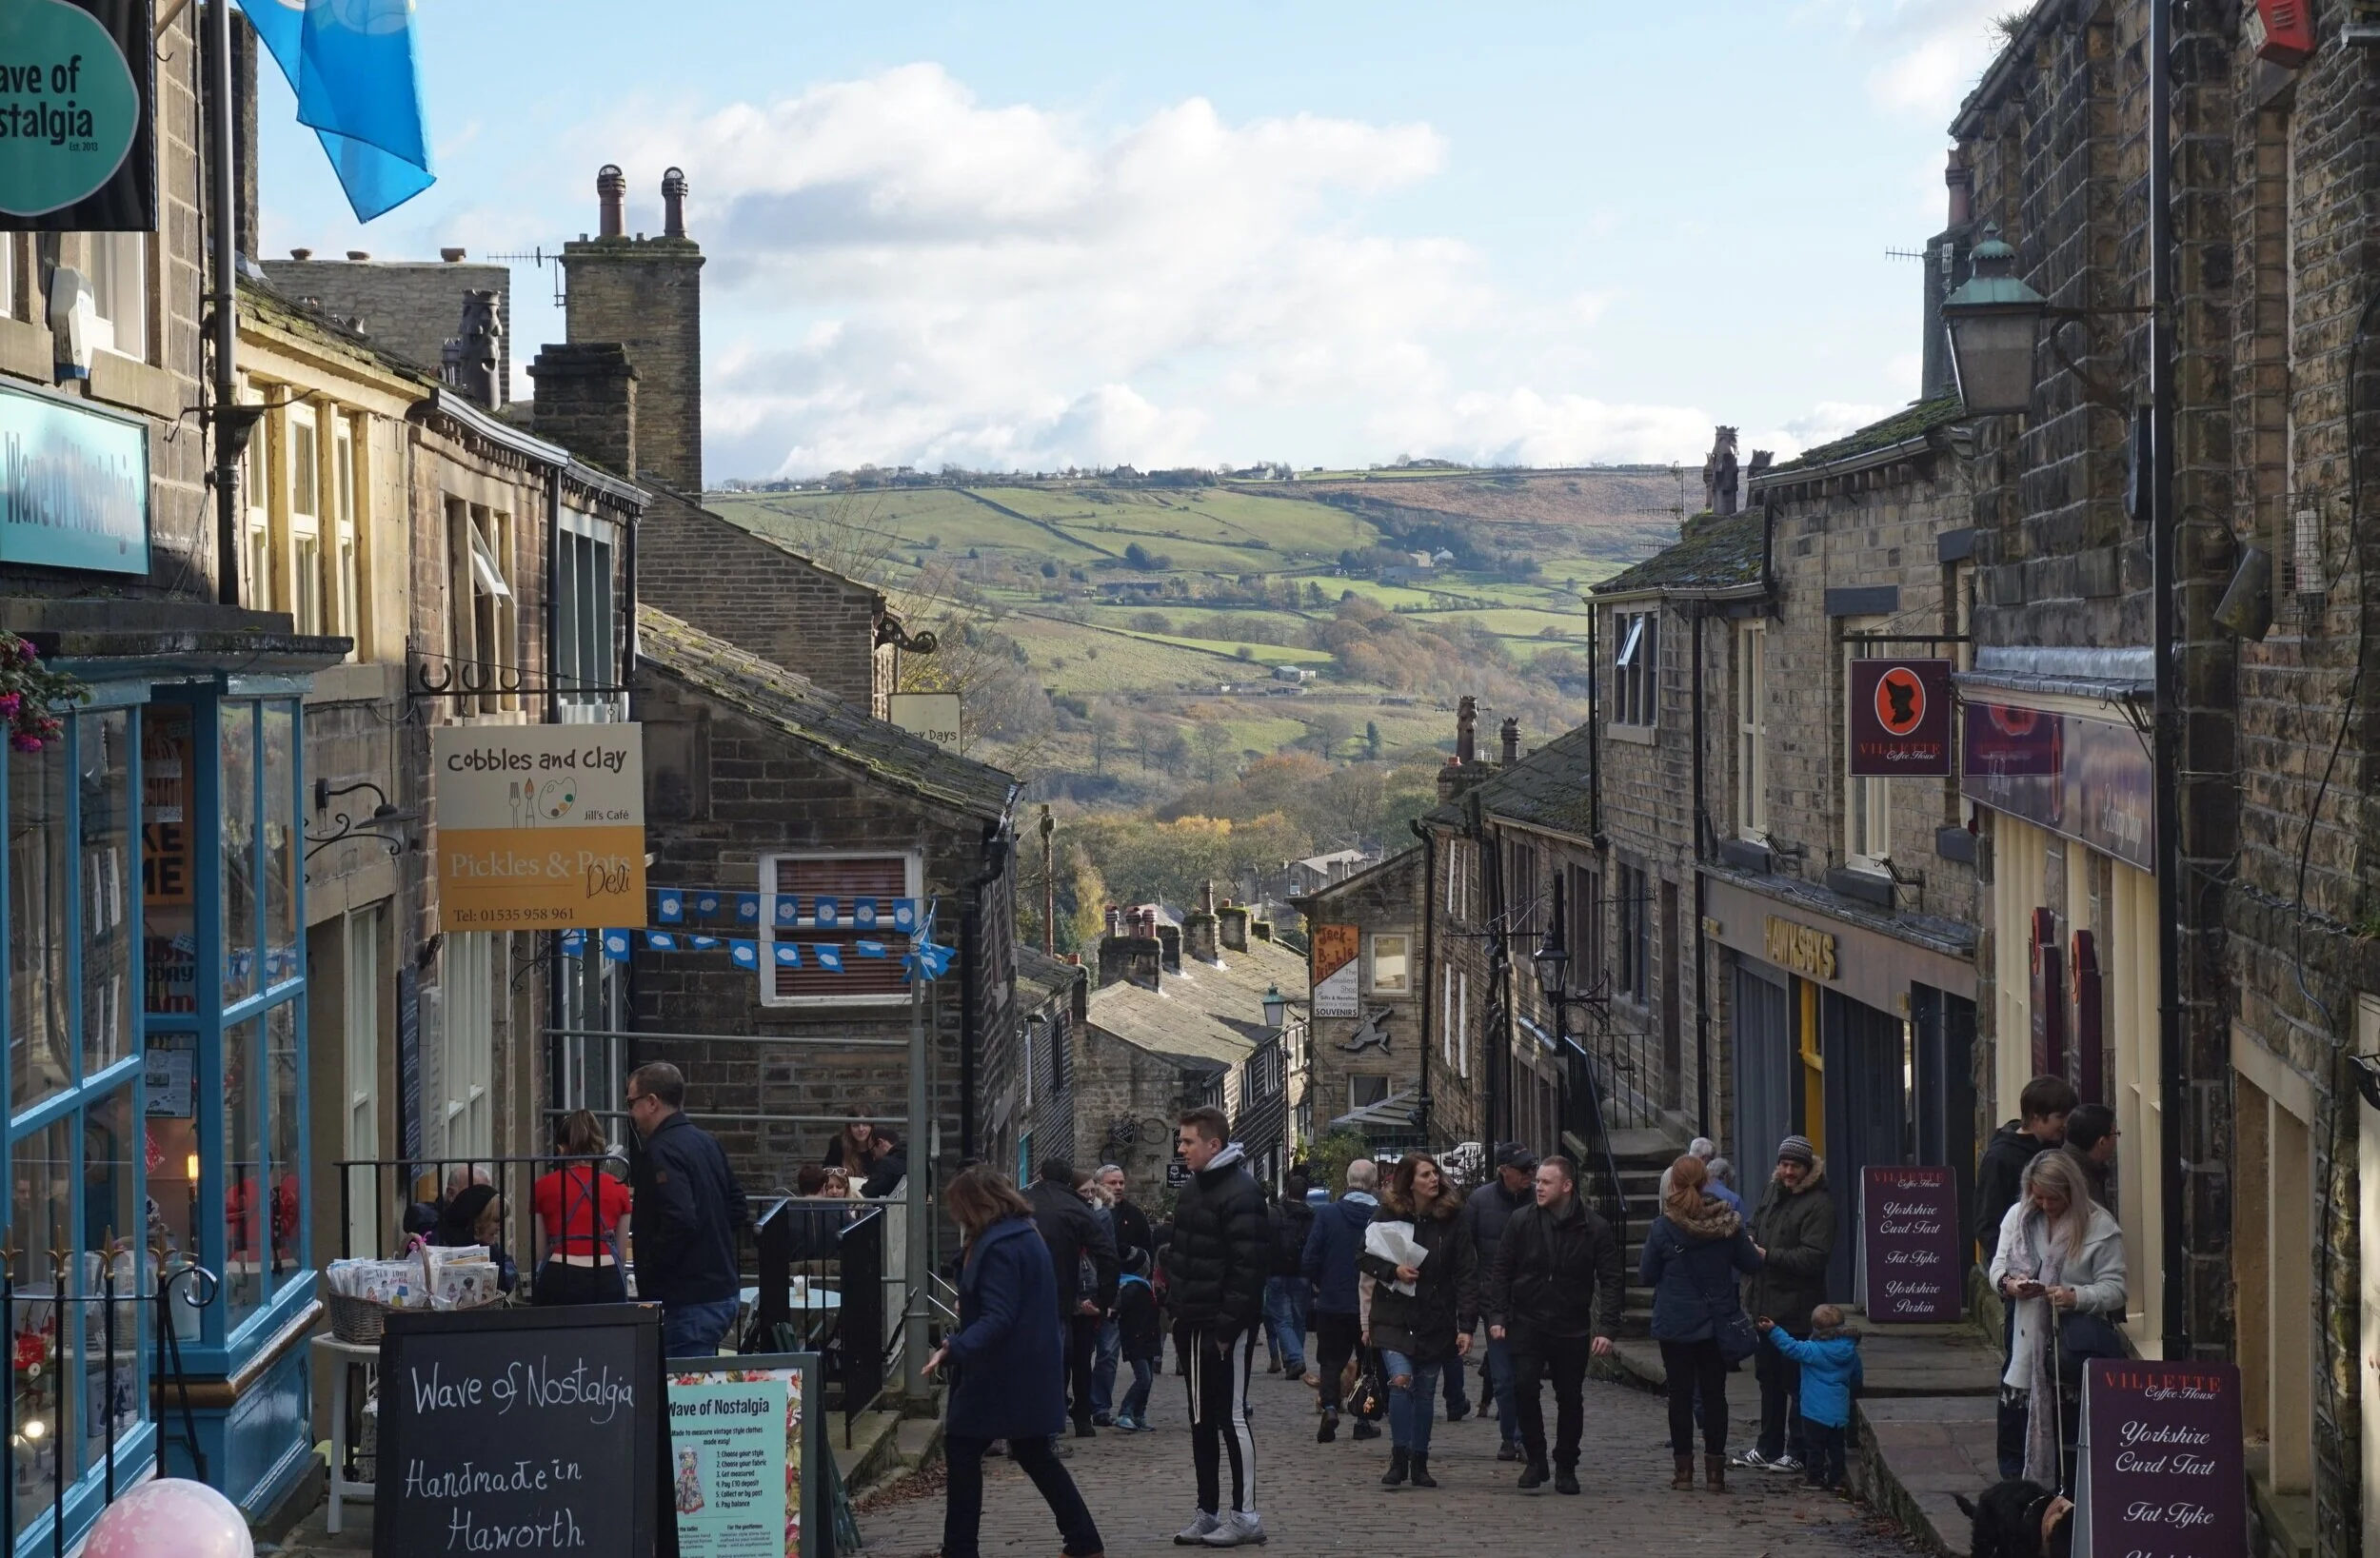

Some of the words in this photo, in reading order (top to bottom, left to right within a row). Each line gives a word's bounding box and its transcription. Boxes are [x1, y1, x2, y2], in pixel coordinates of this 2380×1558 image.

[51, 54, 82, 93] of
[69, 142, 81, 151] Est.
[82, 142, 98, 152] 2013
[928, 729, 957, 743] Days
[1859, 742, 1942, 755] VILLETTE
[1886, 750, 1910, 761] Coffee
[1910, 750, 1936, 760] House
[539, 749, 576, 769] and
[584, 810, 605, 821] Jill's
[606, 809, 629, 820] Café
[449, 851, 540, 878] Pickles
[546, 852, 570, 878] &
[576, 850, 632, 877] Pots
[585, 863, 632, 899] Deli
[453, 909, 478, 923] Tel:
[480, 909, 521, 922] 01535
[524, 908, 548, 921] 958
[551, 907, 575, 920] 961
[1345, 968, 1358, 976] The
[1330, 976, 1358, 985] Smallest
[1340, 986, 1358, 996] Shop
[1316, 1008, 1358, 1016] SOUVENIRS
[1874, 1172, 1945, 1183] VILLETTE
[1897, 1179, 1918, 1190] Coffee
[1917, 1179, 1942, 1189] House
[1883, 1201, 1938, 1219] Yorkshire
[1880, 1220, 1911, 1234] Curd
[1913, 1220, 1942, 1234] Tart
[1885, 1250, 1909, 1265] Fat
[1910, 1250, 1940, 1267] Tyke
[1885, 1280, 1941, 1298] Yorkshire
[1894, 1299, 1935, 1313] Parkin
[411, 1362, 483, 1415] Wave
[491, 1361, 523, 1415] of
[527, 1354, 635, 1425] Nostalgia
[2105, 1371, 2222, 1392] VILLETTE
[2144, 1385, 2178, 1401] Coffee
[2179, 1387, 2217, 1401] House
[699, 1399, 713, 1416] of
[714, 1397, 770, 1417] Nostalgia
[2119, 1420, 2211, 1448] Yorkshire
[2115, 1450, 2168, 1473] Curd
[2170, 1453, 2216, 1476] Tart
[406, 1457, 548, 1499] Handmade
[551, 1458, 583, 1481] in
[741, 1479, 760, 1488] deposit
[721, 1501, 731, 1509] Pay
[2123, 1501, 2163, 1522] Fat
[2164, 1502, 2215, 1529] Tyke
